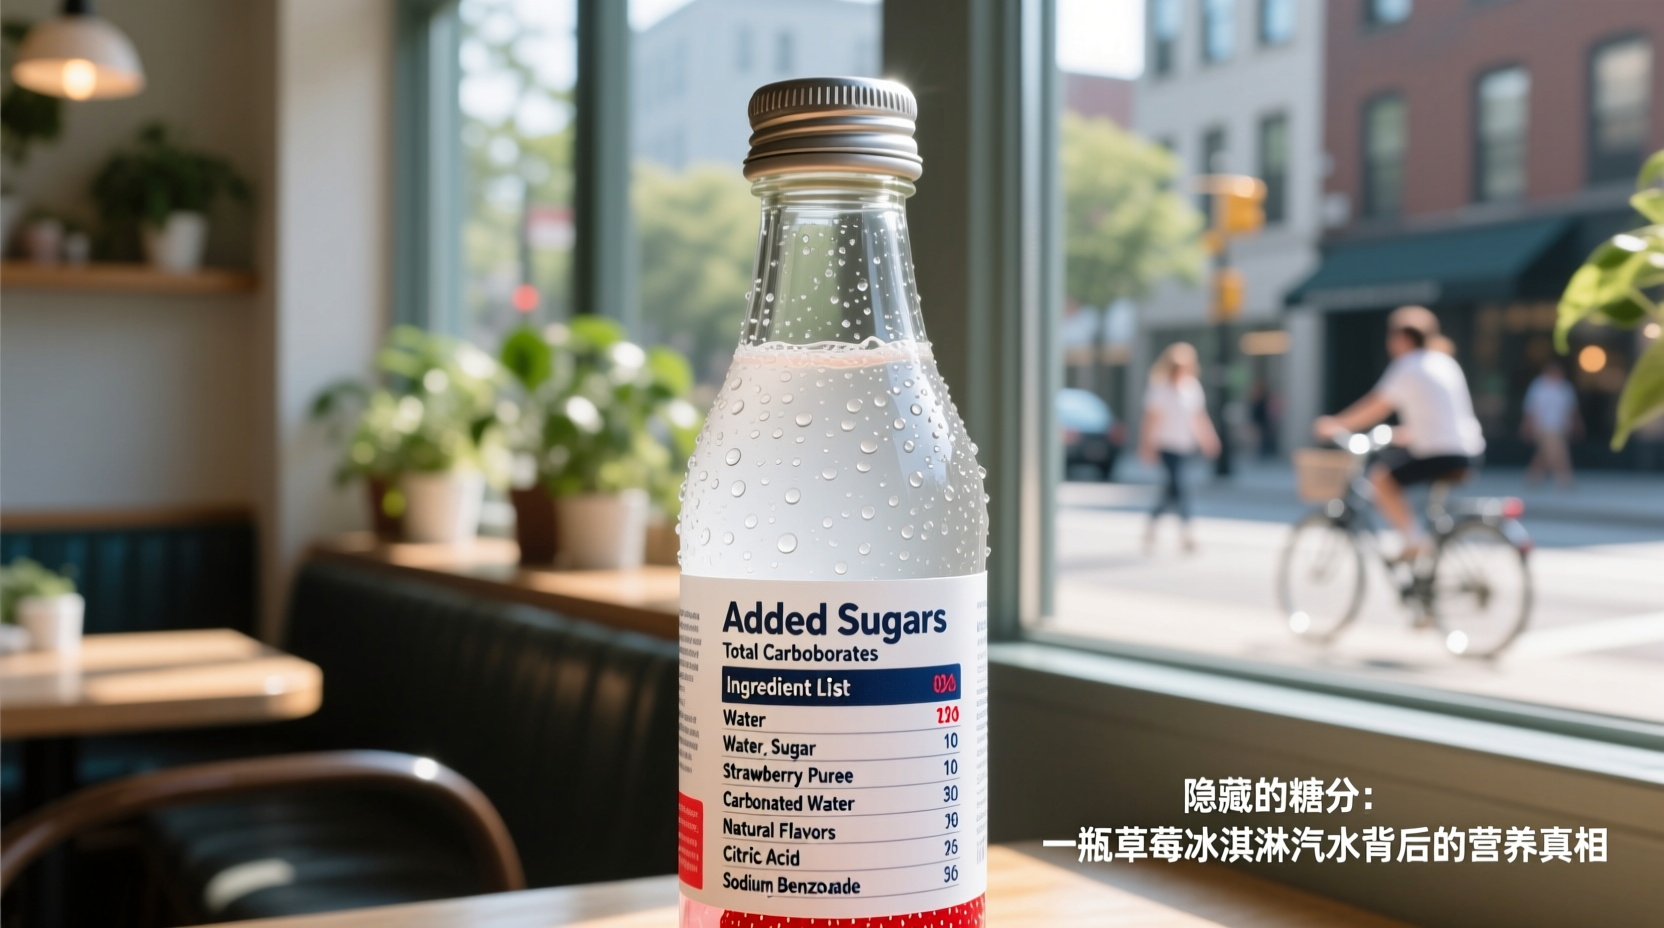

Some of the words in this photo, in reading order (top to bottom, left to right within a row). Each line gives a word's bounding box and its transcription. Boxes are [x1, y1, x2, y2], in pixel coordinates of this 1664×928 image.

[722, 601, 827, 635] Added
[838, 603, 947, 644] Sugars
[722, 642, 758, 661] Total
[763, 644, 879, 662] Carboborates
[726, 675, 812, 699] Ingredient
[817, 677, 851, 697] List
[722, 709, 766, 728] Water
[771, 739, 817, 760] Sugar
[944, 732, 958, 749] 10
[722, 763, 803, 788] Strawberry
[808, 767, 854, 784] Puree
[943, 759, 958, 776] 10
[722, 791, 803, 812] Carbonated
[807, 795, 855, 812] Water
[943, 785, 959, 802] 30
[722, 818, 775, 838] Natural
[779, 823, 836, 840] Flavors
[722, 845, 762, 865] Citric
[766, 849, 800, 866] Acid
[722, 872, 773, 893] Sodium
